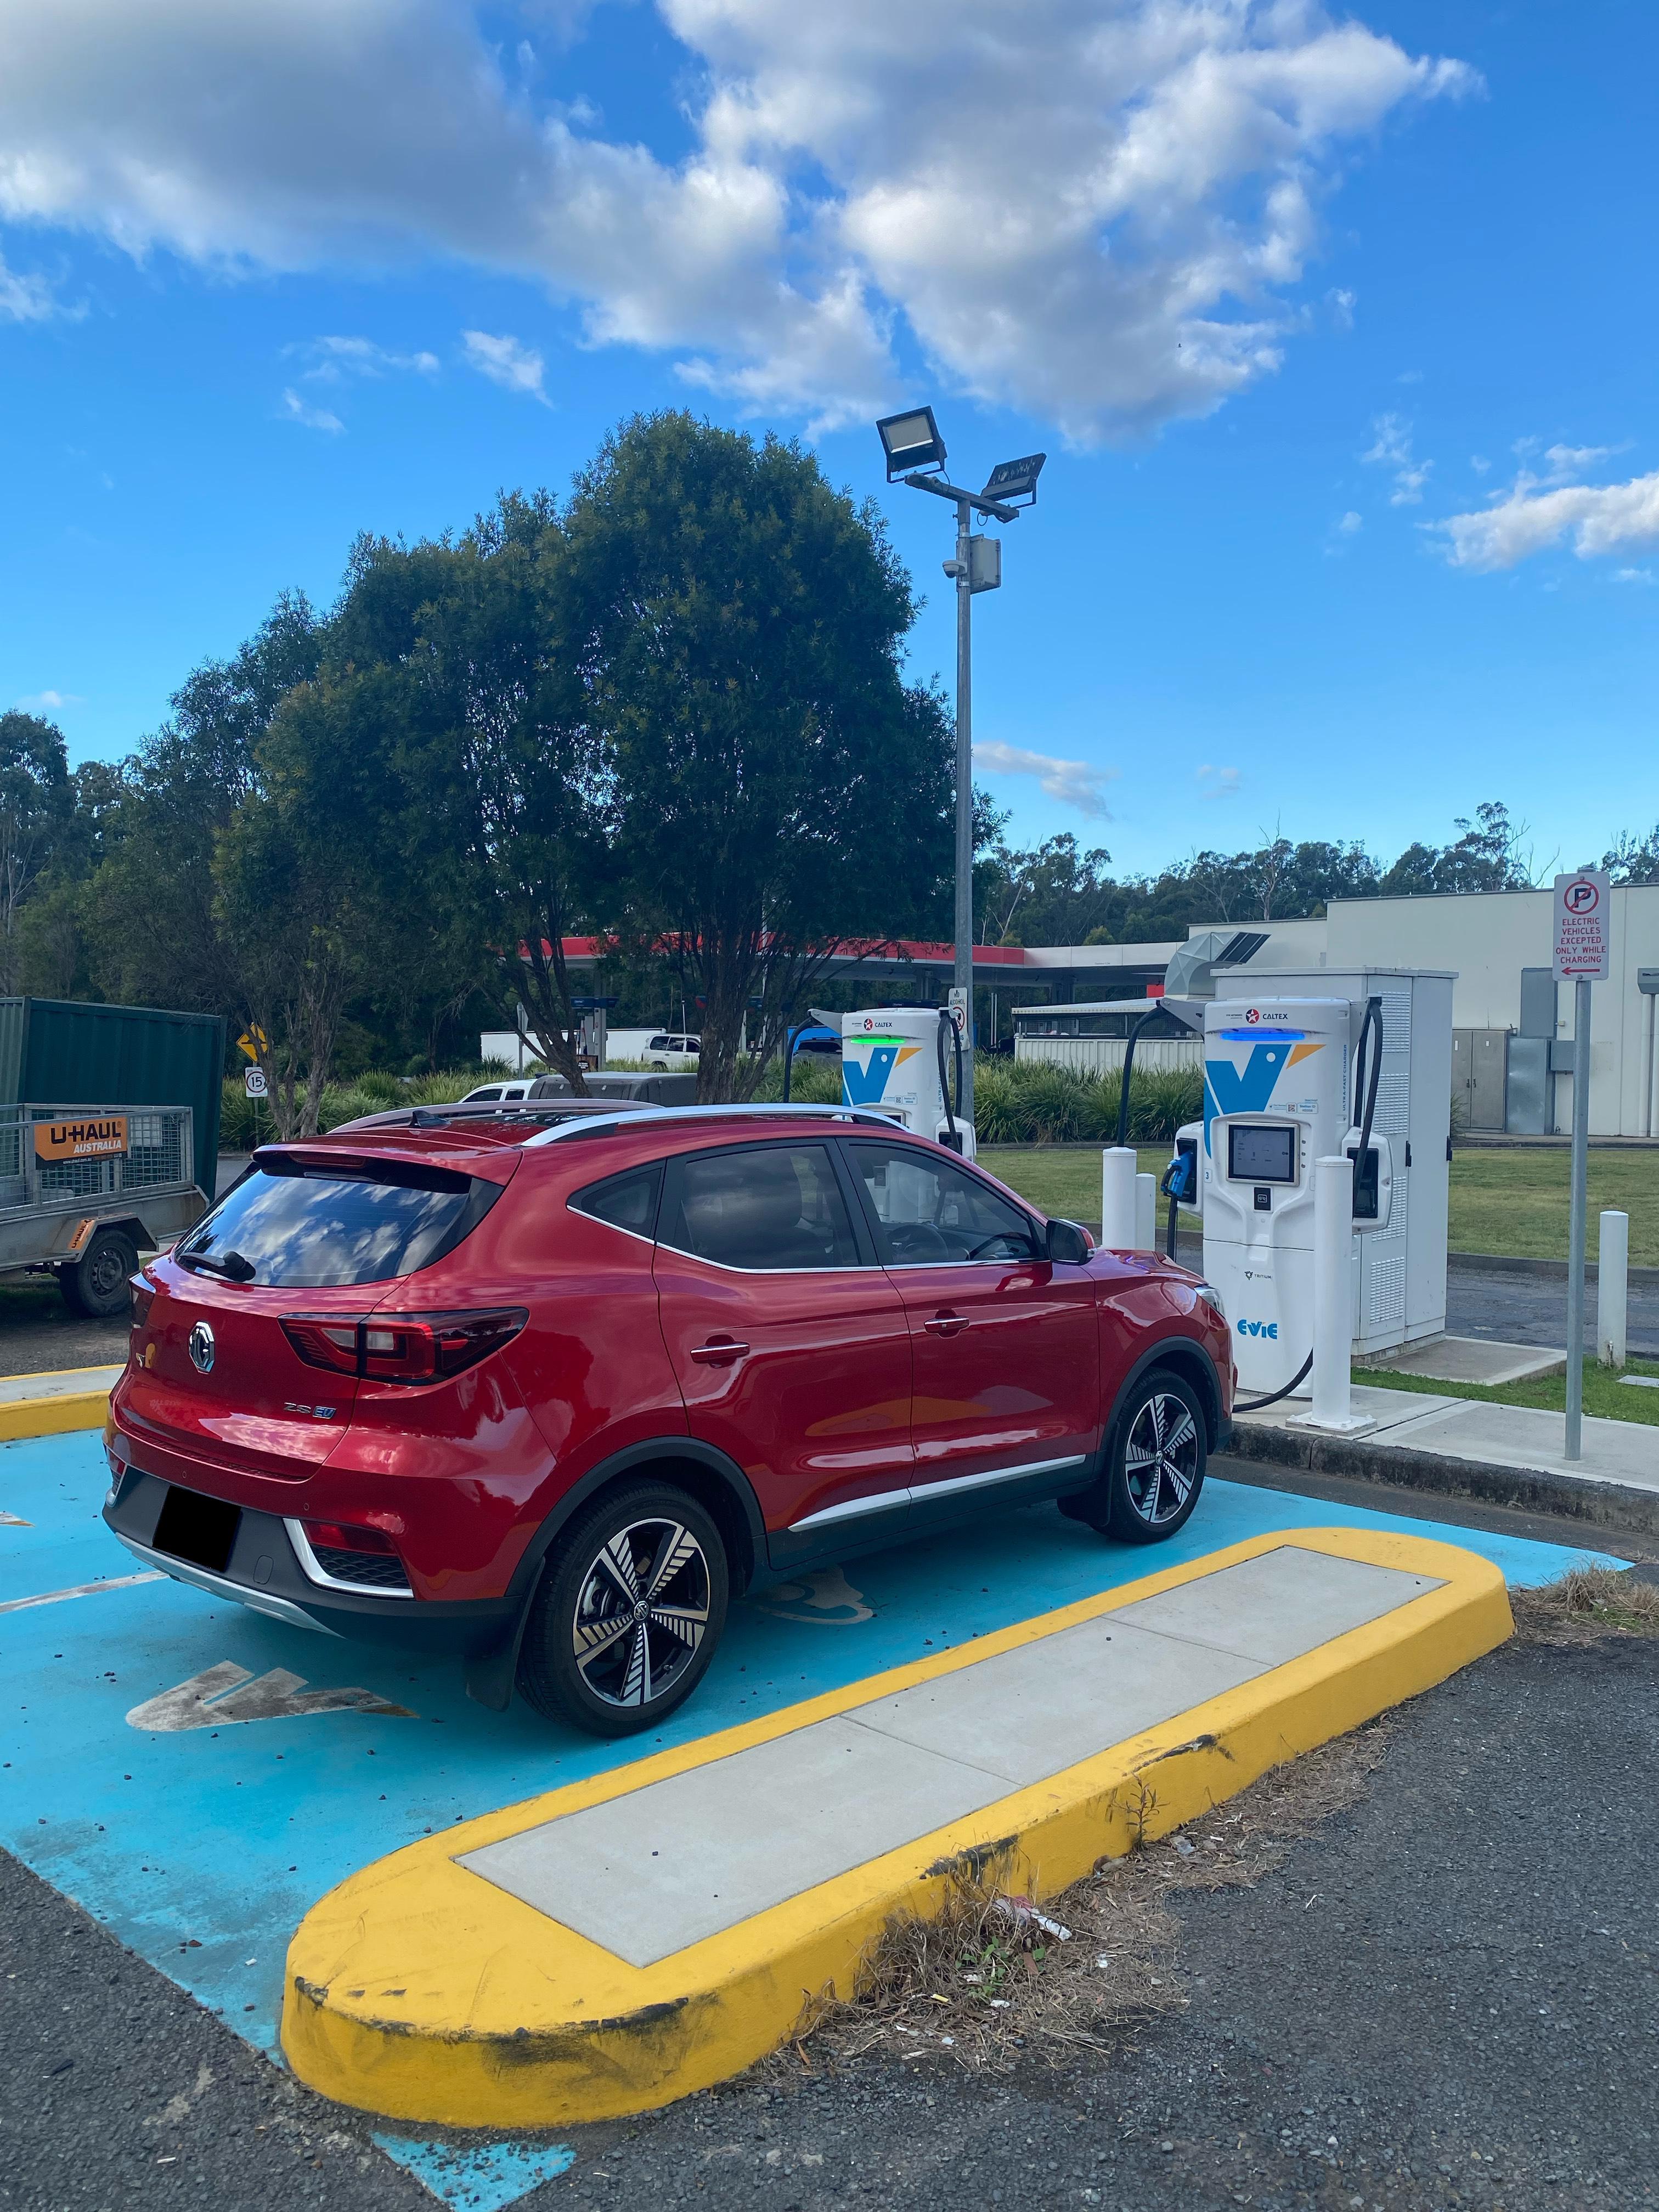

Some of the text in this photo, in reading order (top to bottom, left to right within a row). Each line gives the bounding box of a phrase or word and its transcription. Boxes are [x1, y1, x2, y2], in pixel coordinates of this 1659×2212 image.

[1562, 917, 1600, 926] ELECTRIC
[1562, 927, 1601, 935] VEHICLES
[1561, 936, 1601, 945] EXCEPTED
[1560, 956, 1601, 964] CHARGING
[251, 1076, 262, 1087] 15
[50, 1121, 121, 1144] U-HAUL
[73, 1139, 122, 1154] AUSTRALIA
[1205, 1171, 1209, 1180] 3
[284, 1402, 335, 1418] ZS EV
